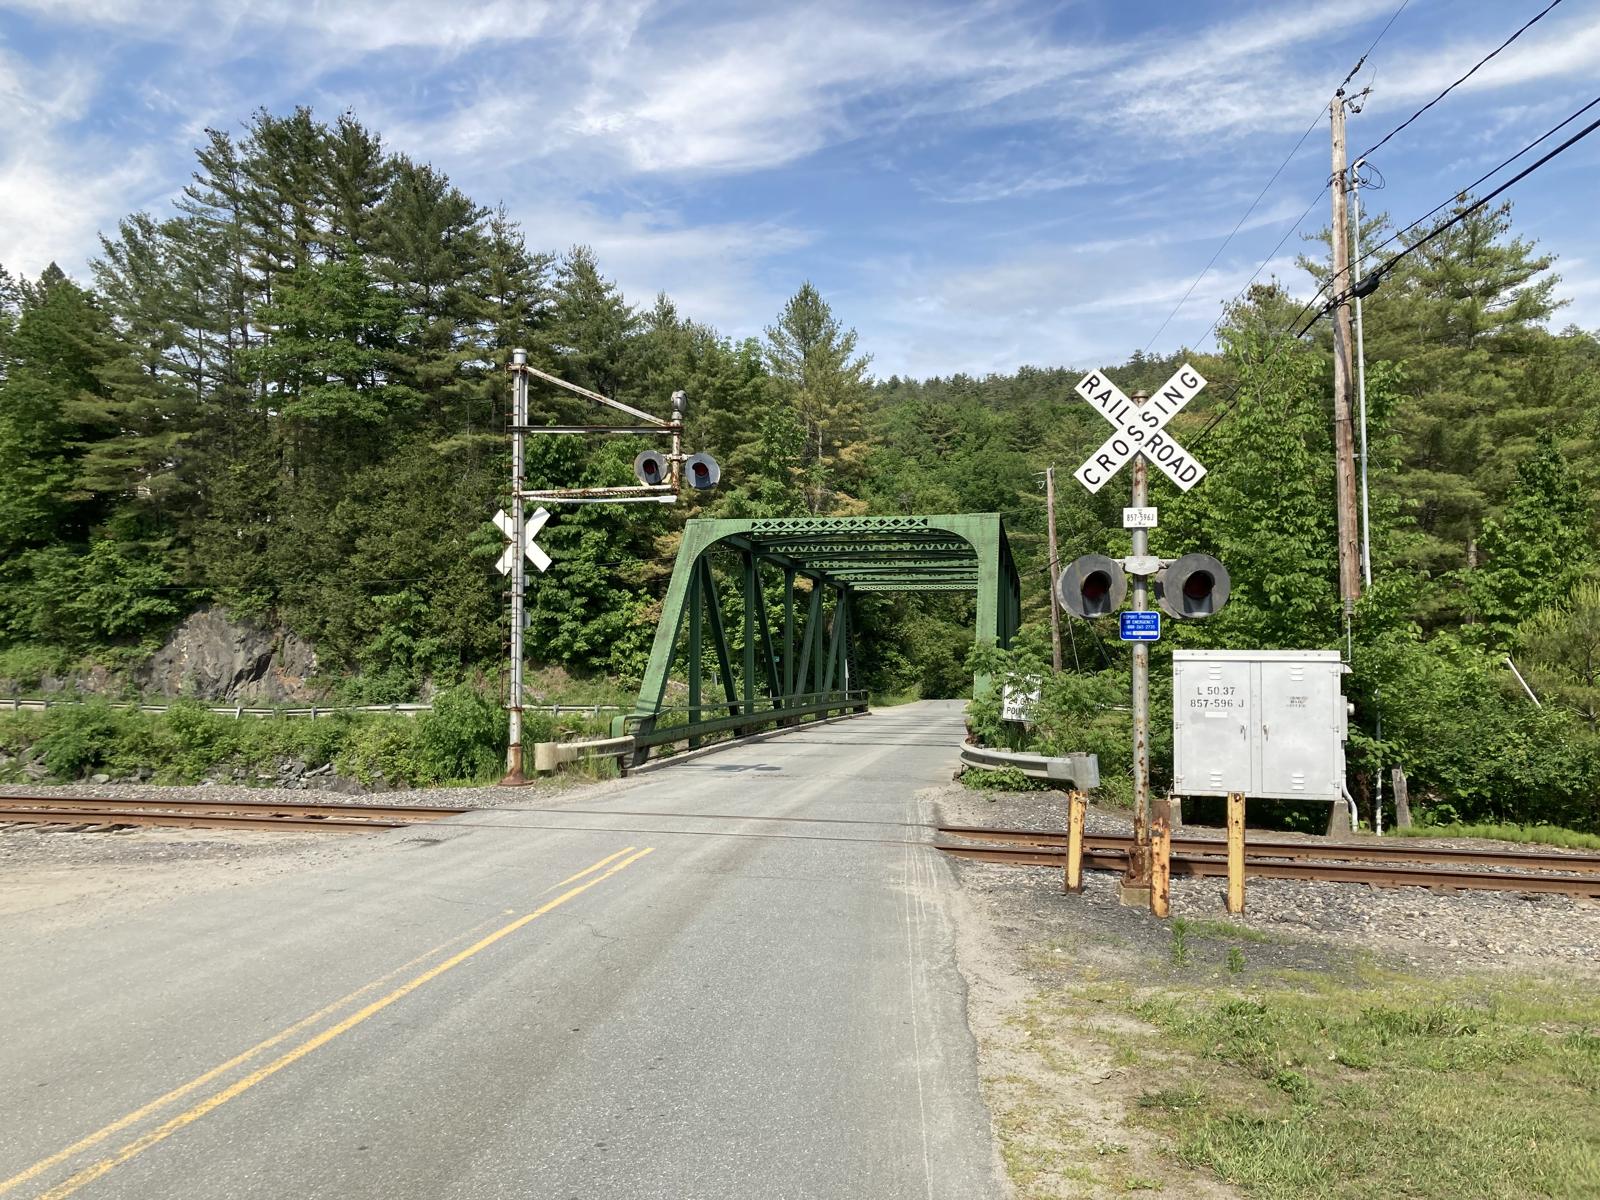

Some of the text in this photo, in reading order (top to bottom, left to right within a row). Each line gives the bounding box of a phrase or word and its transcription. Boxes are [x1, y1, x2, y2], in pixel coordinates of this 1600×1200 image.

[1083, 372, 1199, 485] CROSSING
[1197, 687, 1203, 696] L
[1190, 699, 1245, 708] 857-596 J
